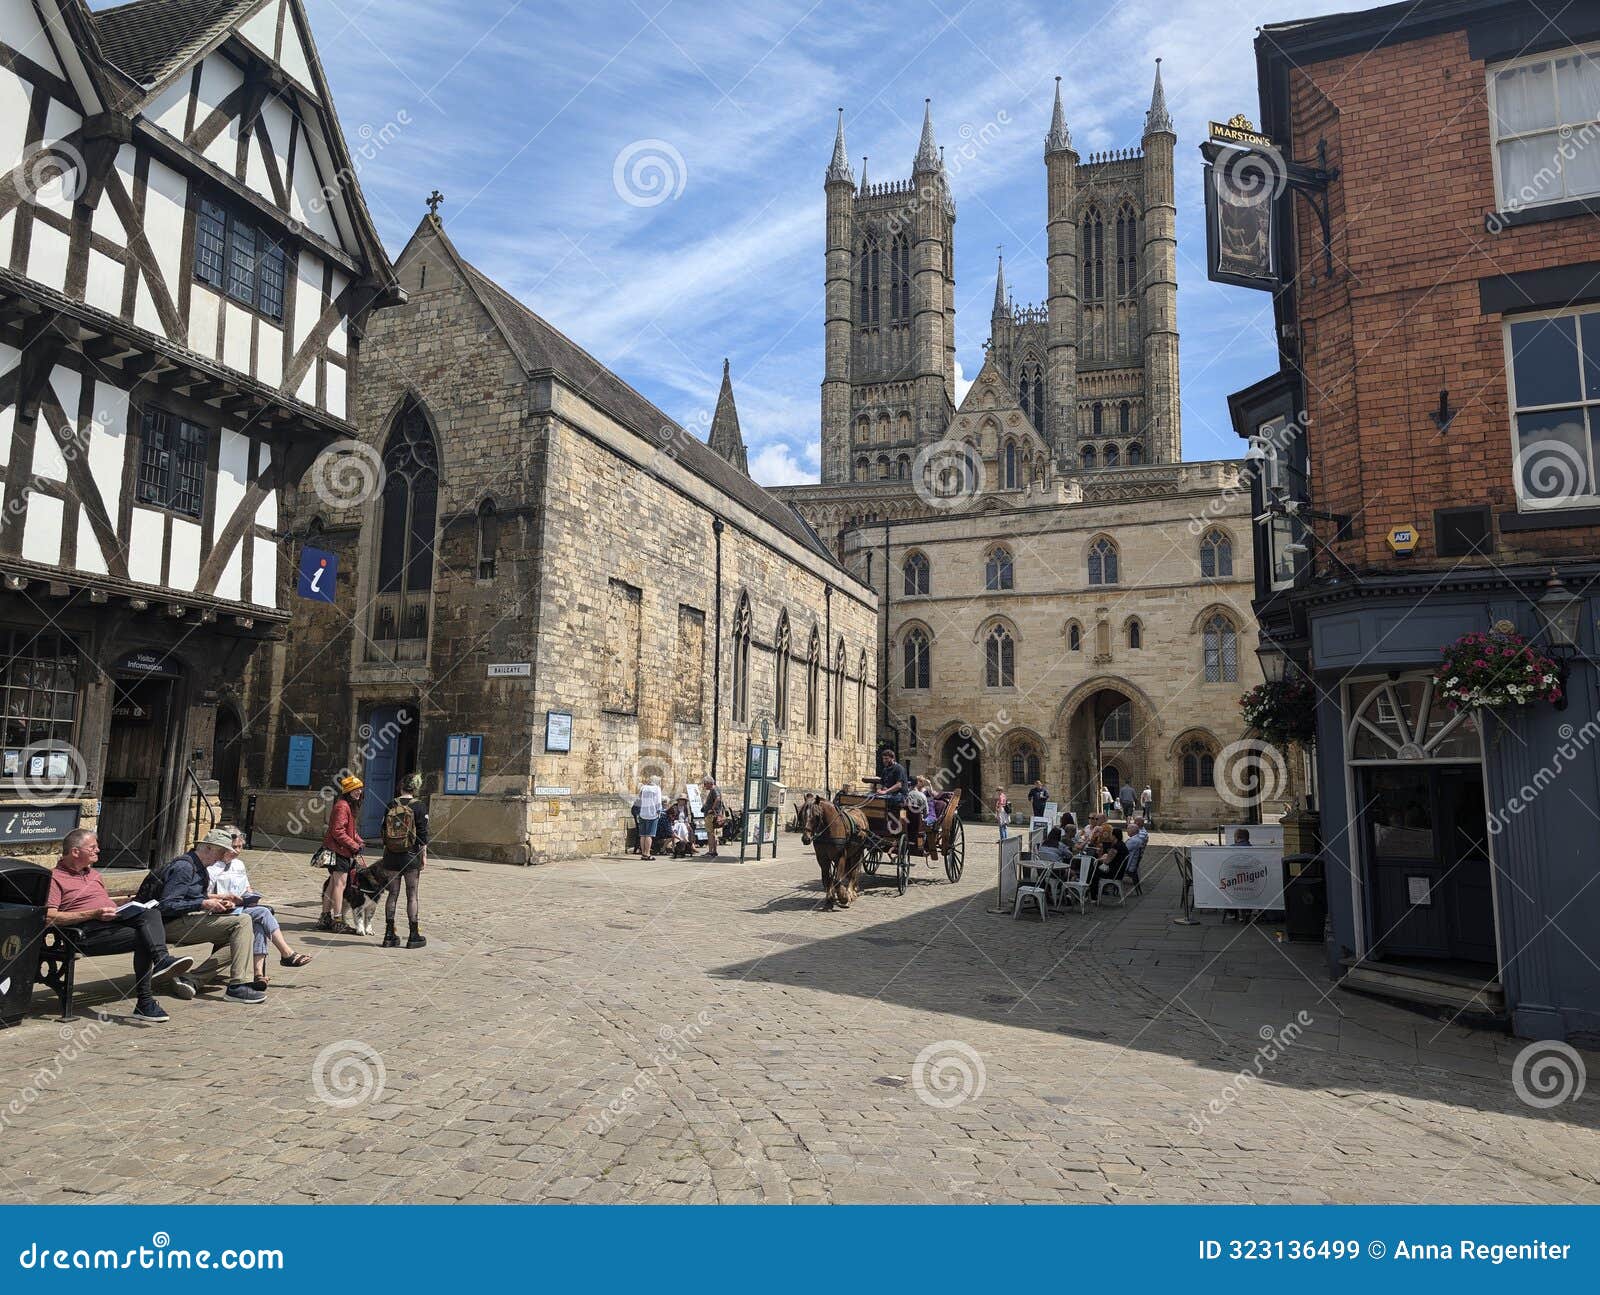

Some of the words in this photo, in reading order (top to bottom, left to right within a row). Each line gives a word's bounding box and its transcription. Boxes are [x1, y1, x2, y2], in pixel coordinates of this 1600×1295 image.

[1214, 125, 1271, 147] MARSTON'S
[1395, 532, 1411, 541] ADT
[137, 653, 156, 662] Visitor
[127, 661, 163, 671] Information
